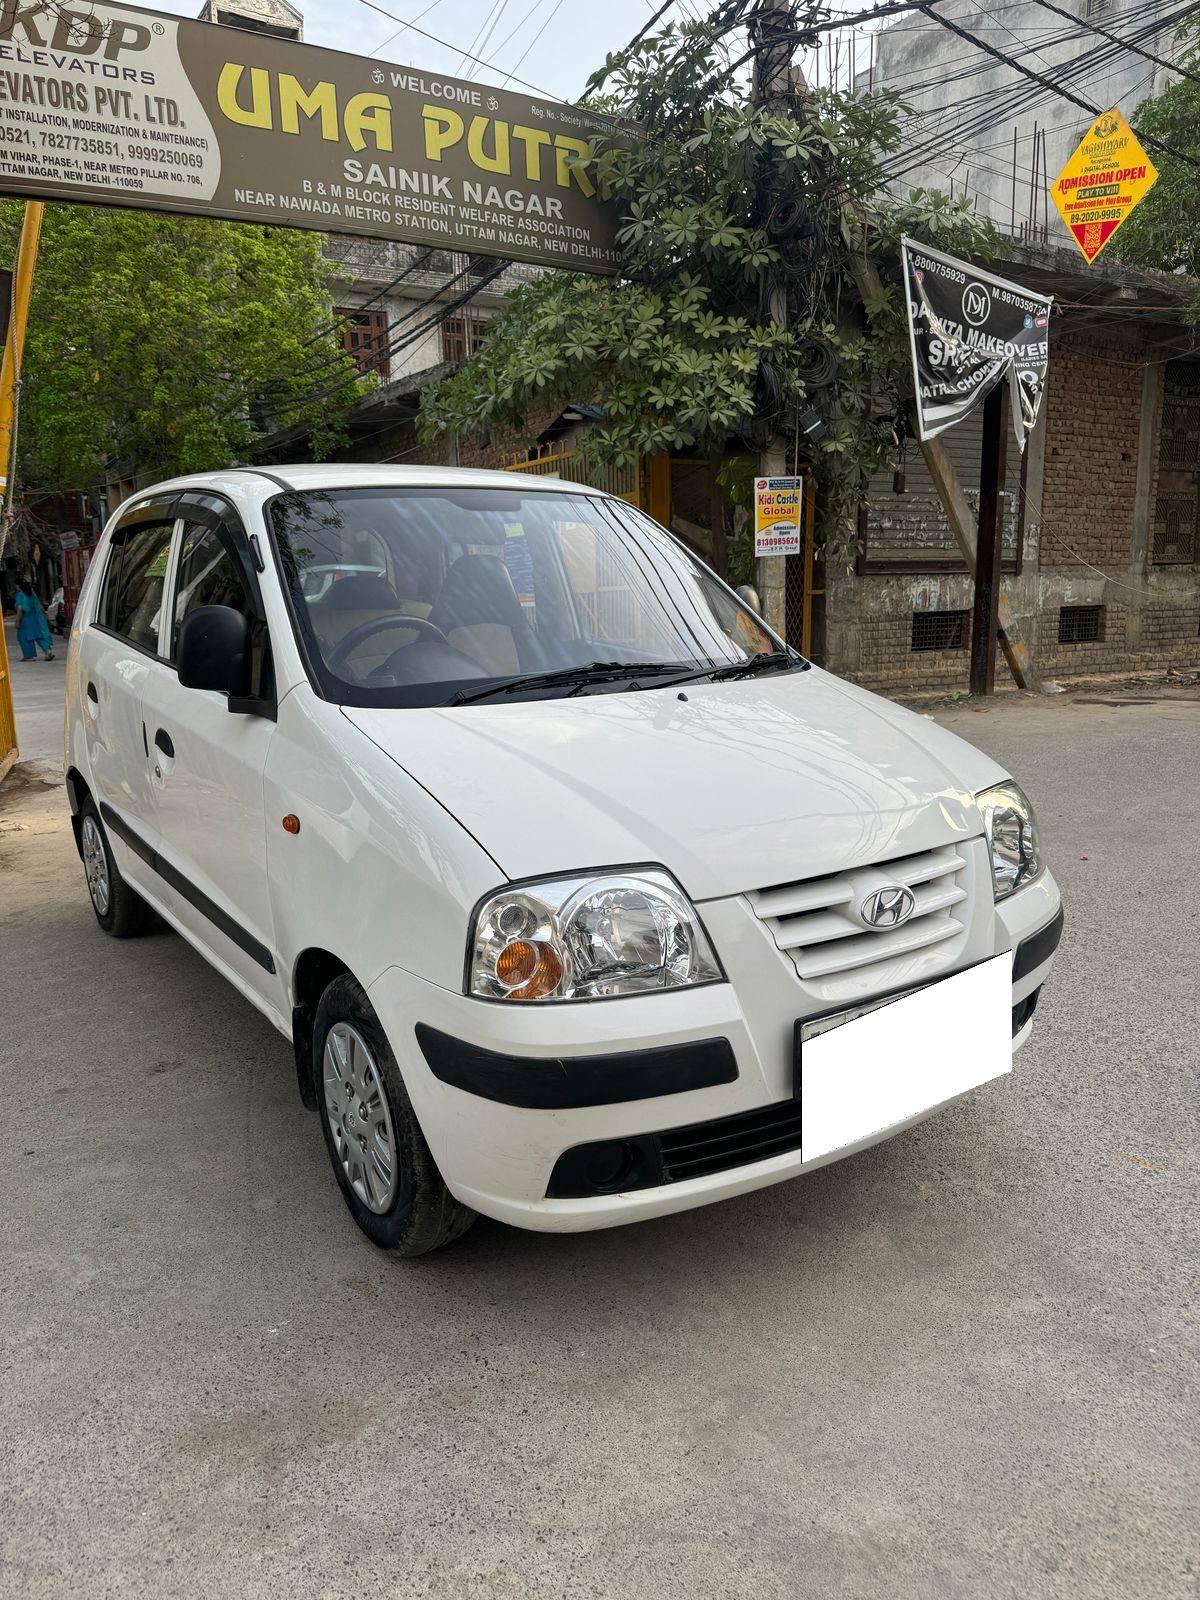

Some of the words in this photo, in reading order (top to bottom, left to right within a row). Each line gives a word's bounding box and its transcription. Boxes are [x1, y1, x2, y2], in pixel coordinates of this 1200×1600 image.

[0, 45, 155, 85] ELEVATORS
[95, 86, 138, 120] PVT.
[144, 95, 185, 128] LTD.
[216, 62, 393, 152] UMA
[390, 72, 482, 107] WELCOME
[531, 105, 545, 118] Reg.
[6, 108, 71, 130] INSTALLATION,
[72, 118, 139, 139] MODERNIZATION
[142, 129, 148, 139] &
[150, 130, 208, 152] MAINTENANCE)
[40, 131, 124, 160] 7827735851,
[128, 144, 203, 168] 9999250069
[10, 151, 41, 166] VIHAR,
[42, 155, 82, 170] PHASE-1,
[84, 160, 107, 172] NEAR
[110, 164, 138, 176] METRO
[140, 168, 169, 181] PILLAR
[171, 173, 185, 183] NO.
[186, 174, 203, 187] 706,
[28, 166, 62, 180] NAGAR,
[64, 170, 83, 182] NEW
[85, 173, 110, 185] DELHI
[1057, 172, 1114, 195] ADMISSION
[1115, 166, 1147, 182] OPEN
[343, 159, 453, 199] SAINIK
[463, 180, 564, 220] NAGAR
[1077, 188, 1095, 199] PLAY
[1095, 187, 1105, 196] TO
[234, 189, 275, 208] NEAR
[280, 194, 342, 216] NAWADA
[345, 205, 391, 224] METRO
[395, 212, 452, 236] STATION,
[455, 222, 496, 241] UTTAM
[499, 230, 542, 251] NAGAR,
[544, 238, 569, 255] NEW
[303, 180, 312, 193] B
[317, 182, 327, 195] &
[331, 184, 342, 198] M
[346, 188, 391, 206] BLOCK
[395, 194, 456, 217] RESIDENT
[459, 206, 515, 229] WELFARE
[517, 219, 591, 241] ASSOCIATION
[965, 329, 1048, 360] MAKEOVER
[758, 494, 775, 505] Kids
[776, 493, 799, 505] Castle
[763, 506, 794, 515] Global
